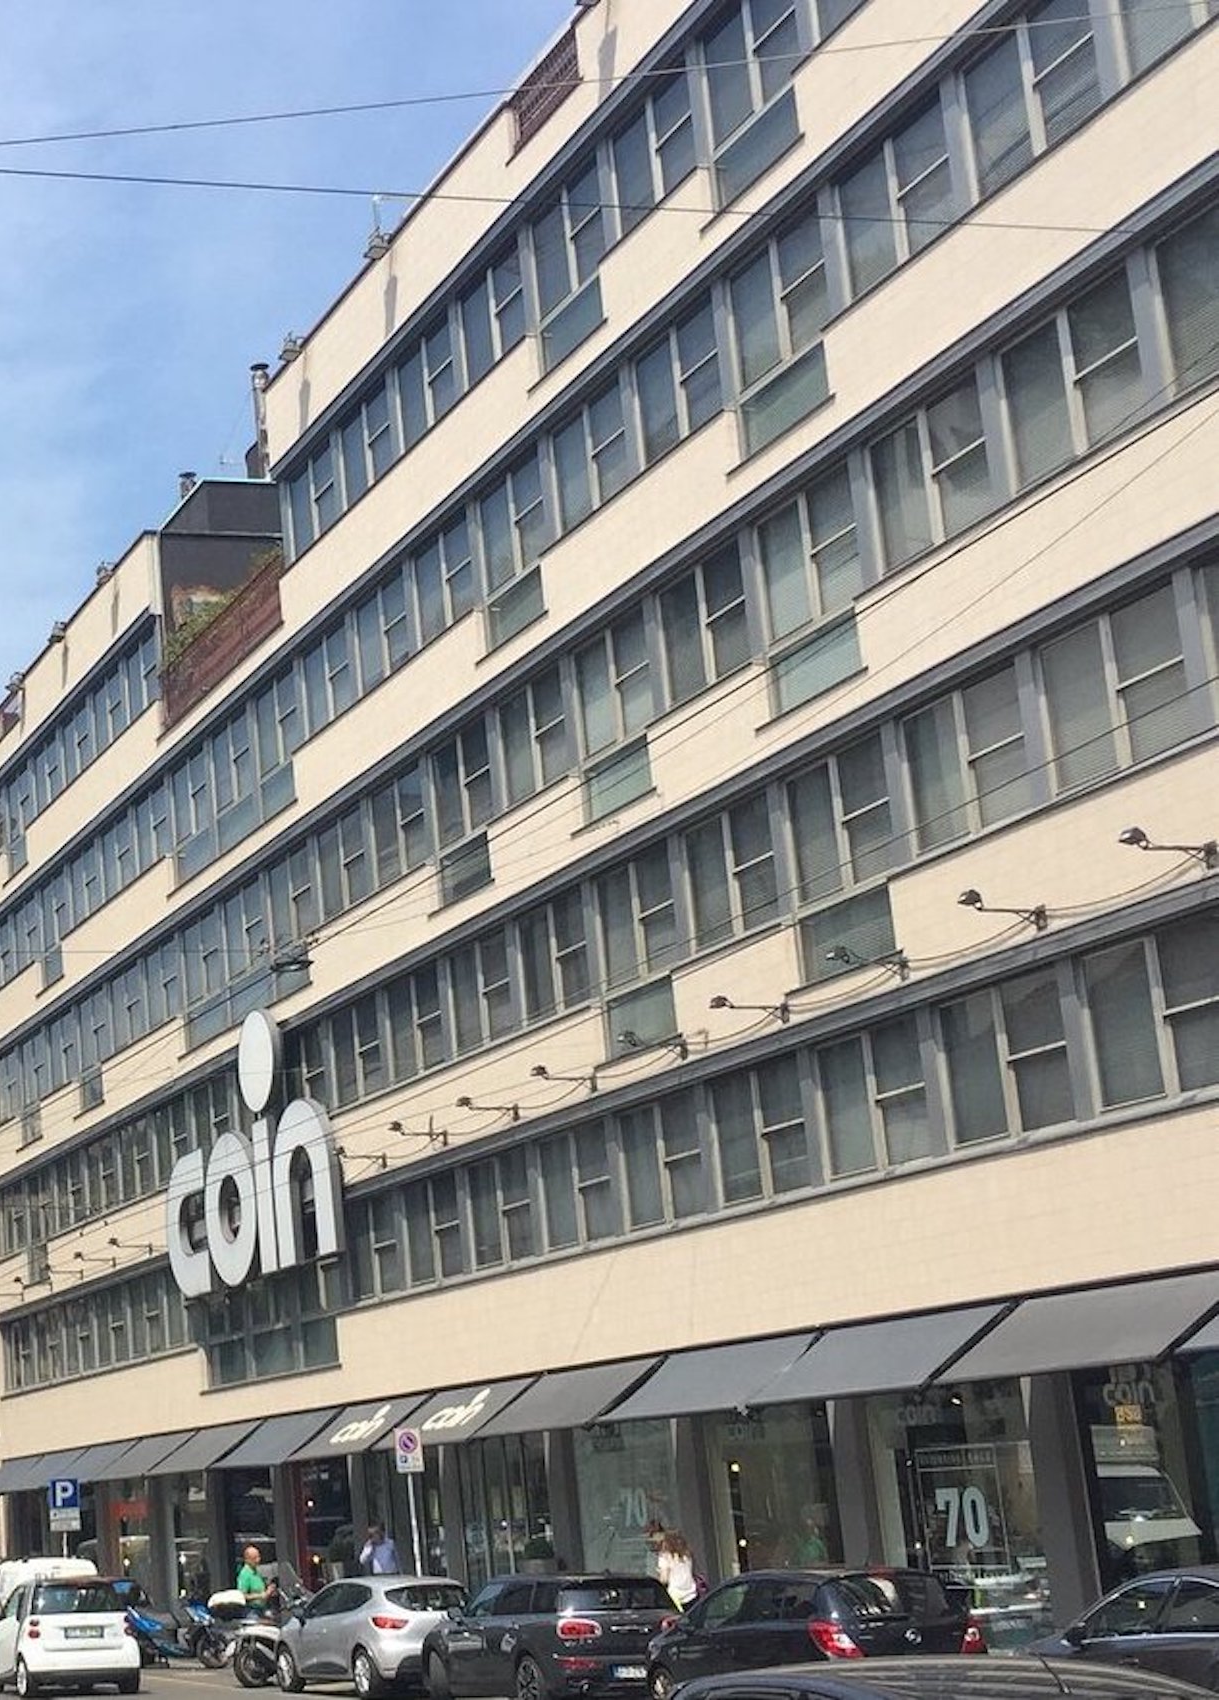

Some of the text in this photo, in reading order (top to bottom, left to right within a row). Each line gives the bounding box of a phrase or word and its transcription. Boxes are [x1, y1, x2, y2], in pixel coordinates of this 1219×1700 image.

[167, 1010, 345, 1298] coin
[329, 1387, 491, 1444] coin coin
[1102, 1382, 1156, 1408] coin
[56, 1481, 74, 1507] P
[935, 1486, 990, 1548] 70
